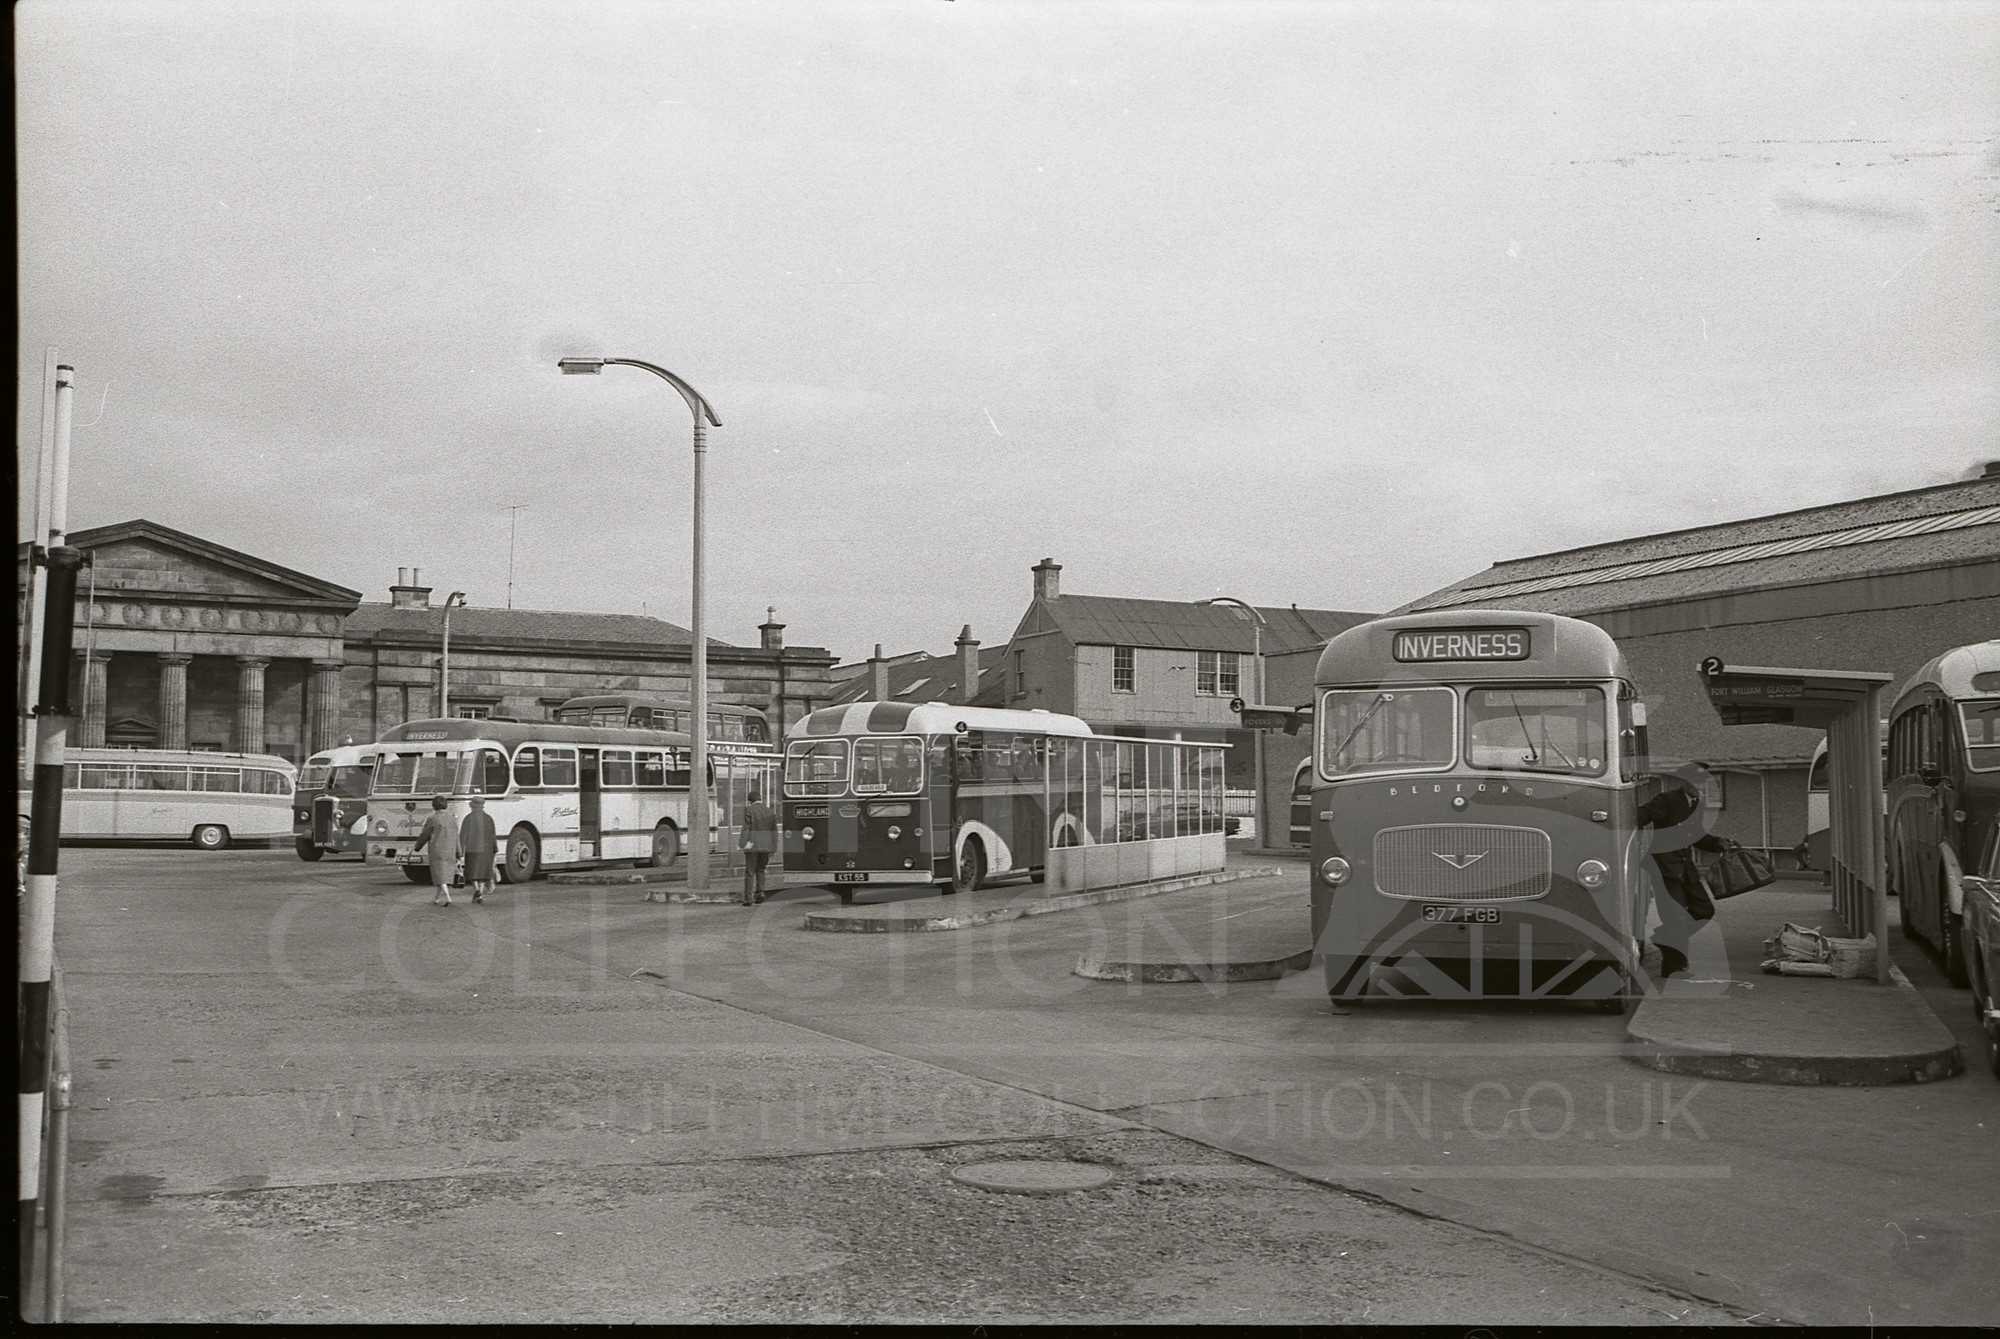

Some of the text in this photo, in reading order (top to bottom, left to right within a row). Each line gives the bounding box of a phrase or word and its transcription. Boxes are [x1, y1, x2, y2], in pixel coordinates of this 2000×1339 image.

[1398, 633, 1522, 660] INVERNESS
[1706, 658, 1719, 676] 2
[1234, 698, 1242, 712] 3
[957, 721, 966, 732] 4
[795, 806, 831, 818] HIGHLAND
[1425, 906, 1499, 923] 377 FGB
